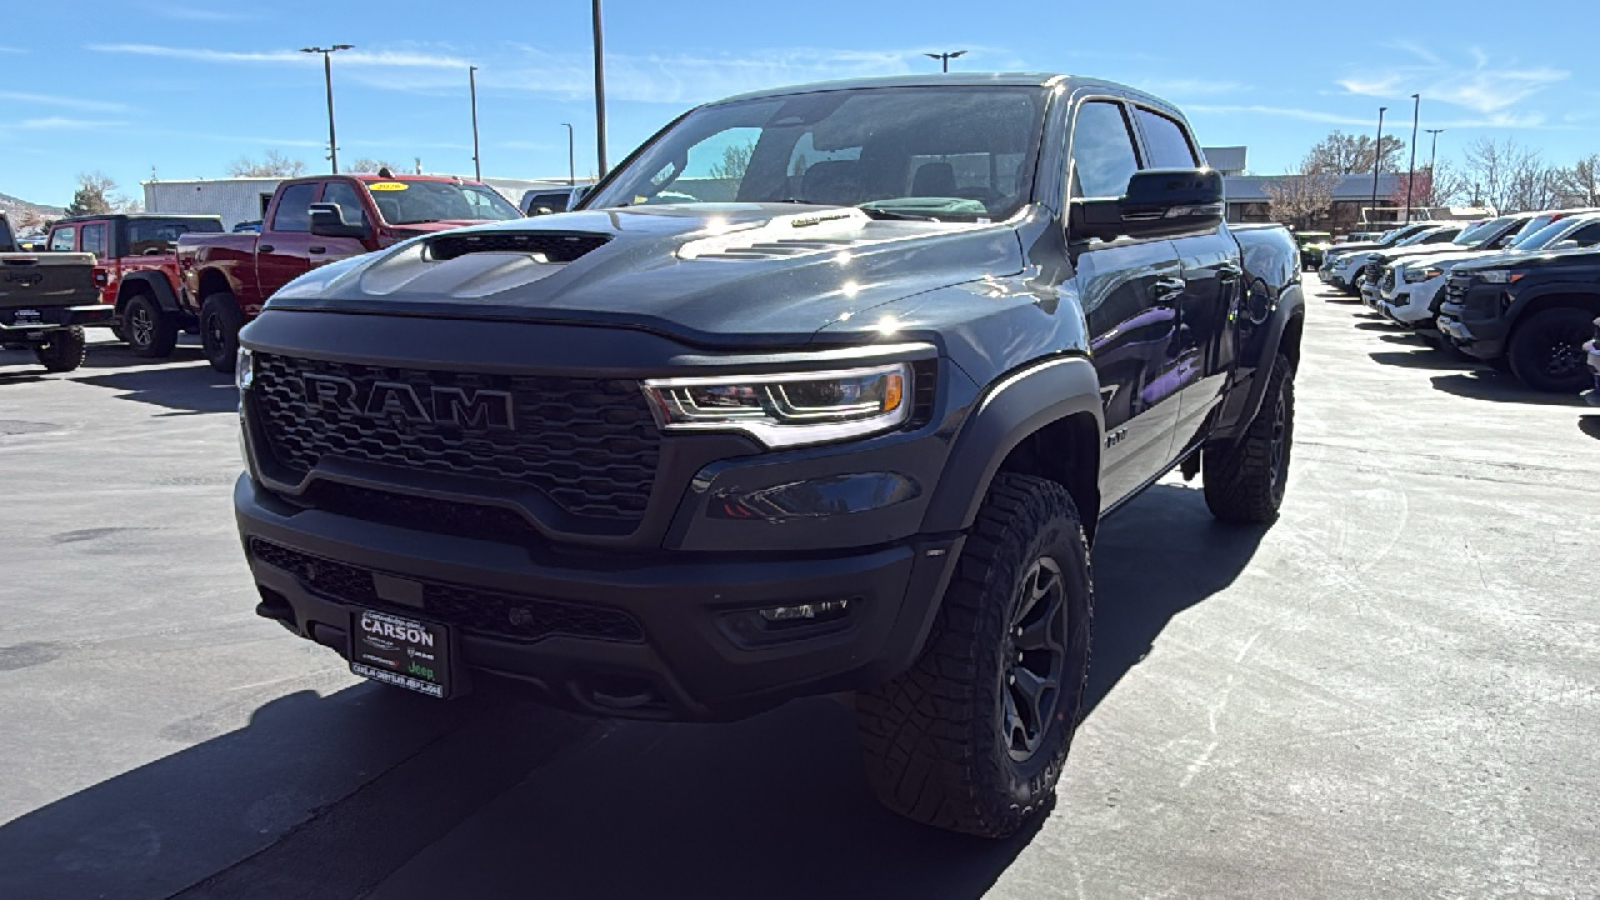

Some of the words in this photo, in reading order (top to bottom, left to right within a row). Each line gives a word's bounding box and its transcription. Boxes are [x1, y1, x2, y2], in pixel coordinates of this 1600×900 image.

[303, 373, 515, 430] RAM
[361, 618, 434, 647] CARSON
[408, 661, 433, 680] Jeep
